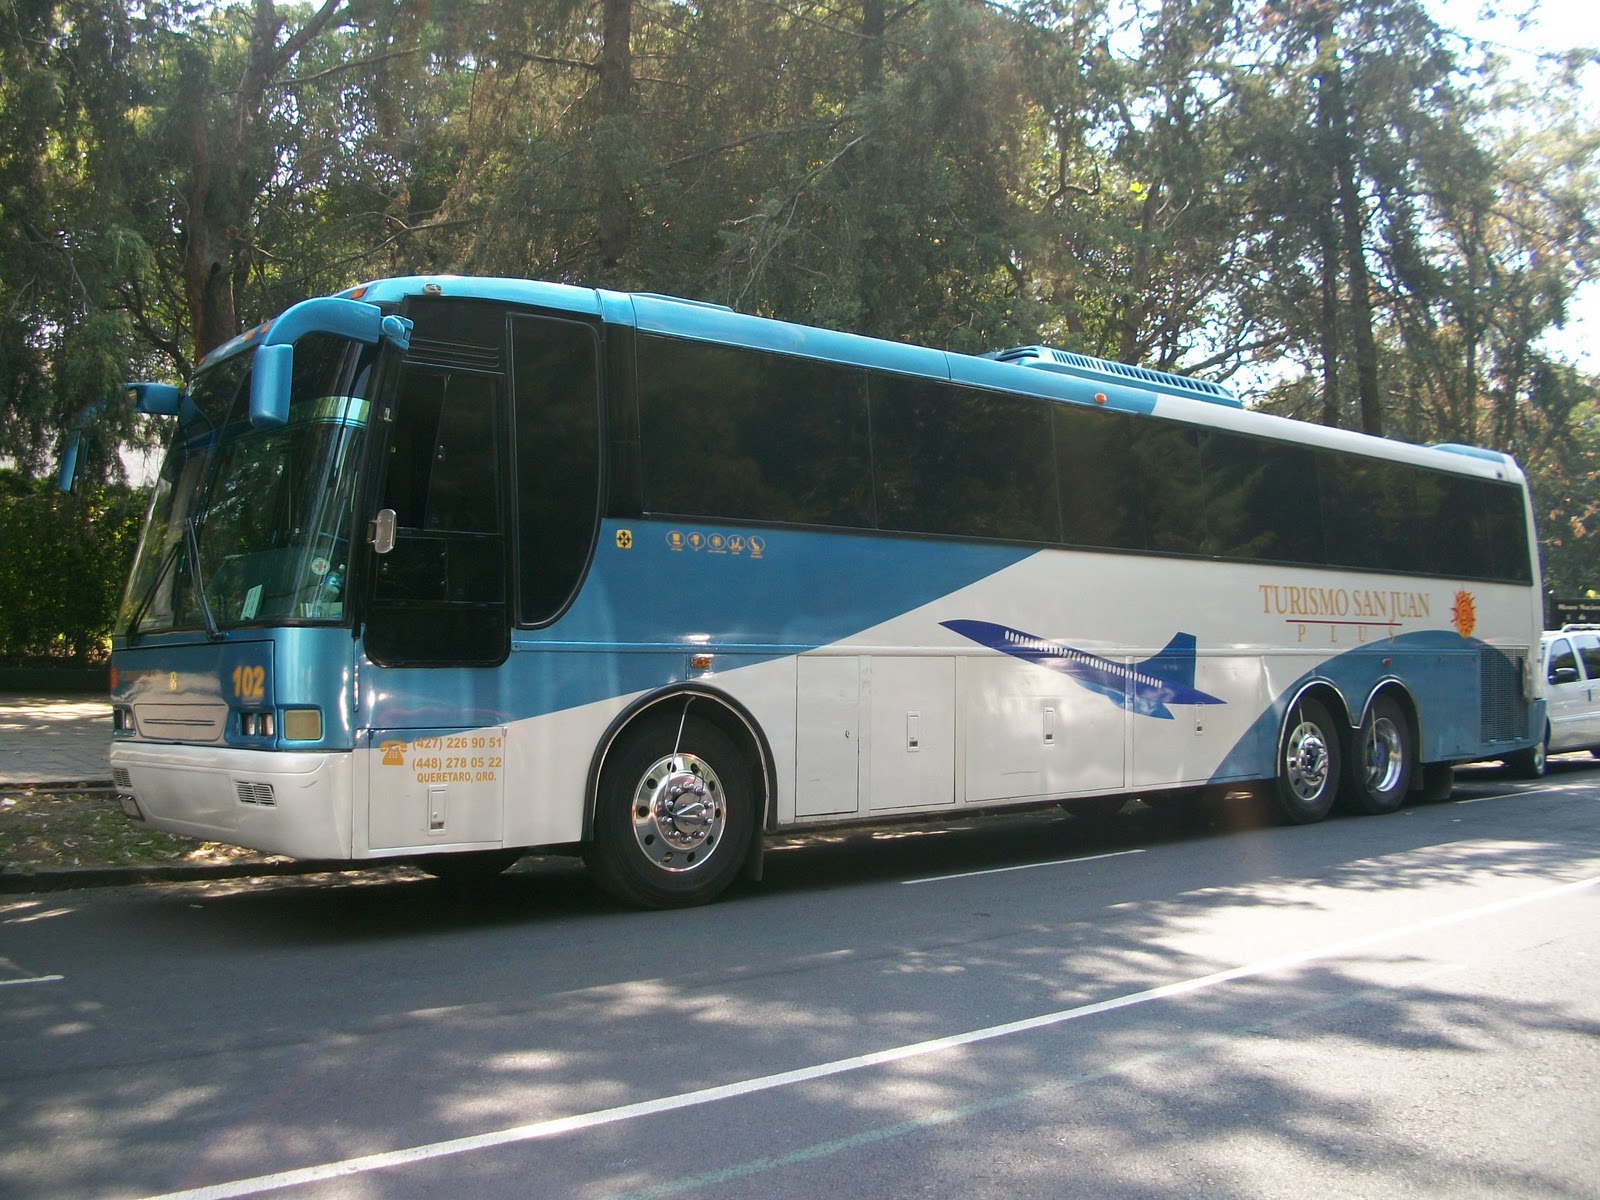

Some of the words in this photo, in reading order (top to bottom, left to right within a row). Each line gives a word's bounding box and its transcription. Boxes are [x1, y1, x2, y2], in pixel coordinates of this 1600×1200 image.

[1259, 584, 1349, 616] TURISMO
[1353, 589, 1387, 617] SAN
[1390, 591, 1431, 622] JUAN
[232, 665, 265, 698] 102
[413, 738, 443, 751] (427)
[446, 737, 468, 749] 226
[471, 737, 486, 749] 90
[489, 736, 502, 748] 51
[412, 758, 443, 771] (448)
[446, 757, 467, 769] 278
[470, 757, 485, 769] 05
[488, 757, 502, 768] 22
[417, 771, 474, 783] QUERETARO,
